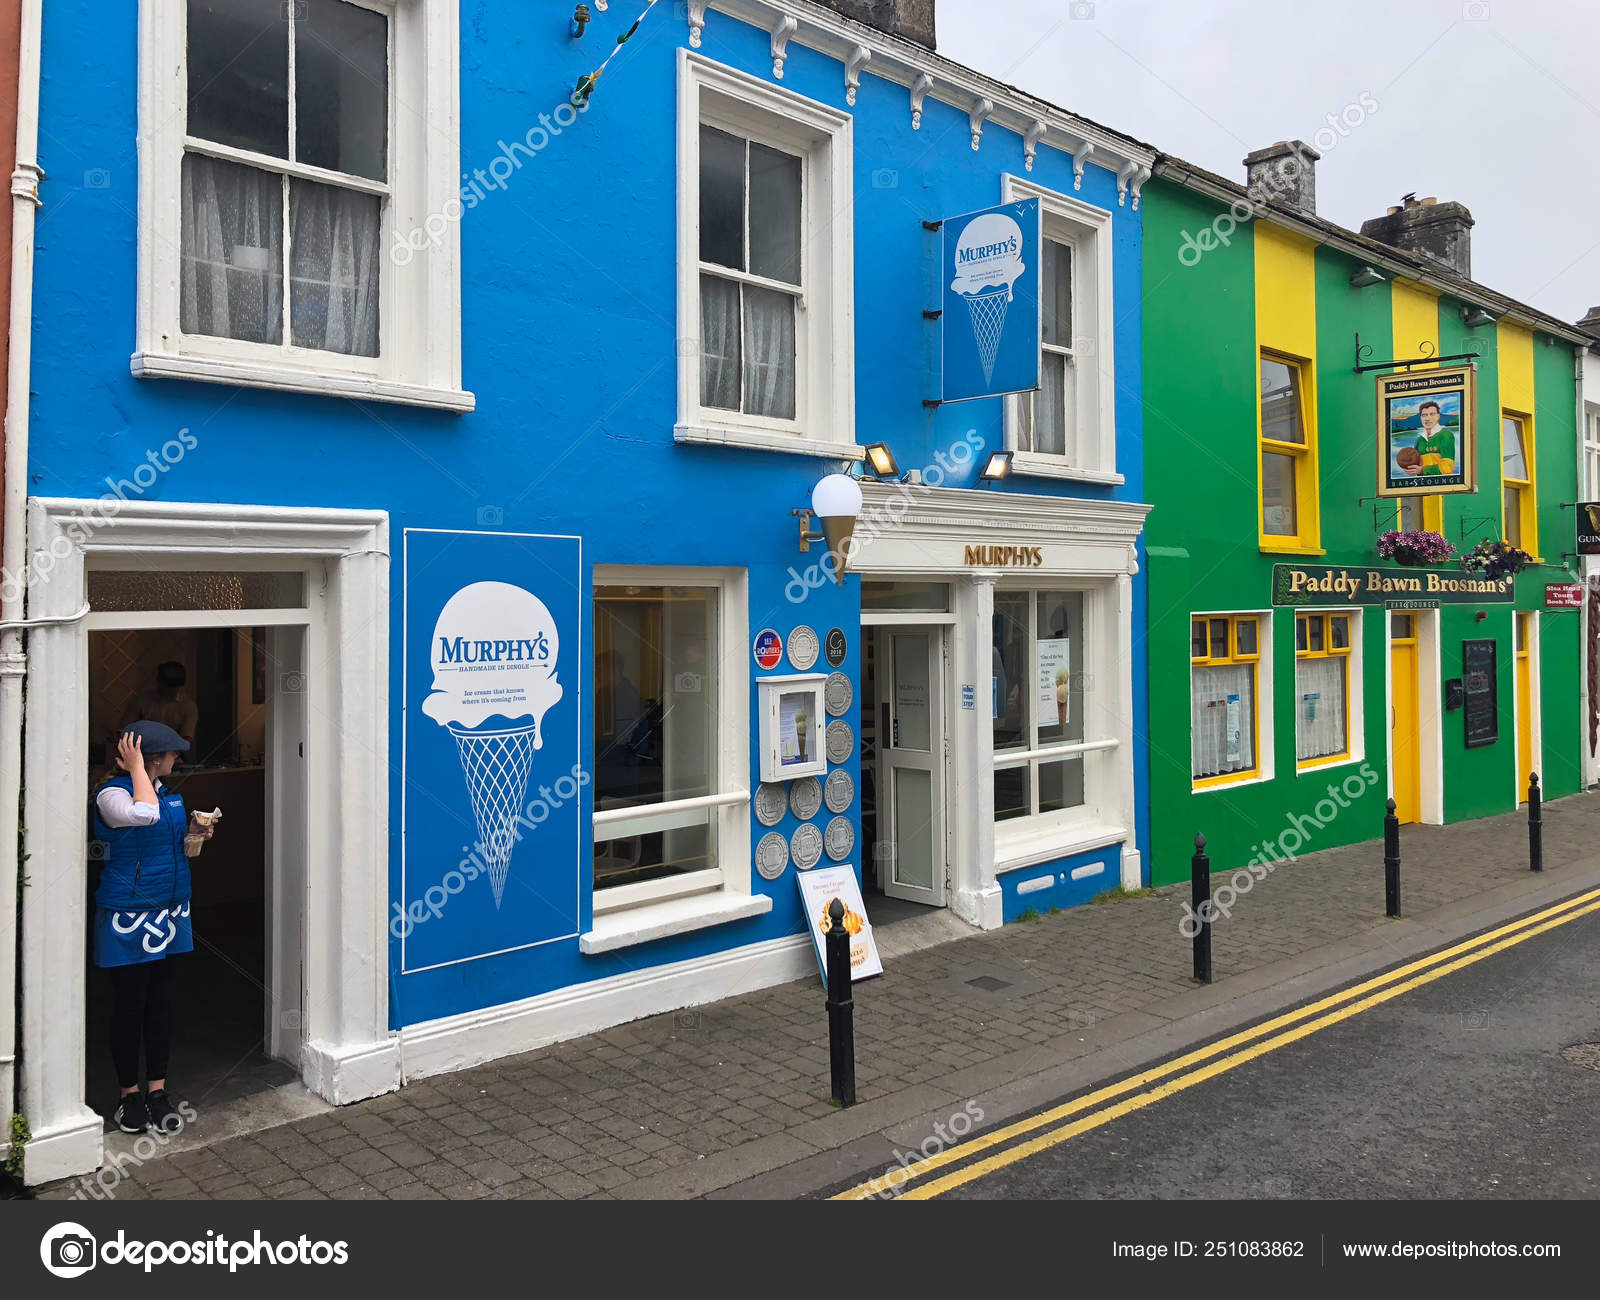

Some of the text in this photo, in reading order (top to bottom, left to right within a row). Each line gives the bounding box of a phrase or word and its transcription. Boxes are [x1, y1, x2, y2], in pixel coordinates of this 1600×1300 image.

[1389, 383, 1409, 391] Paddy
[1410, 380, 1428, 388] Bawn
[964, 543, 1043, 567] MURPHYS
[1289, 570, 1508, 600] Paddy Bawn Brosnan's
[439, 631, 549, 663] MURPHY'S
[458, 665, 497, 673] HANDMADE
[506, 663, 530, 671] DINGLE
